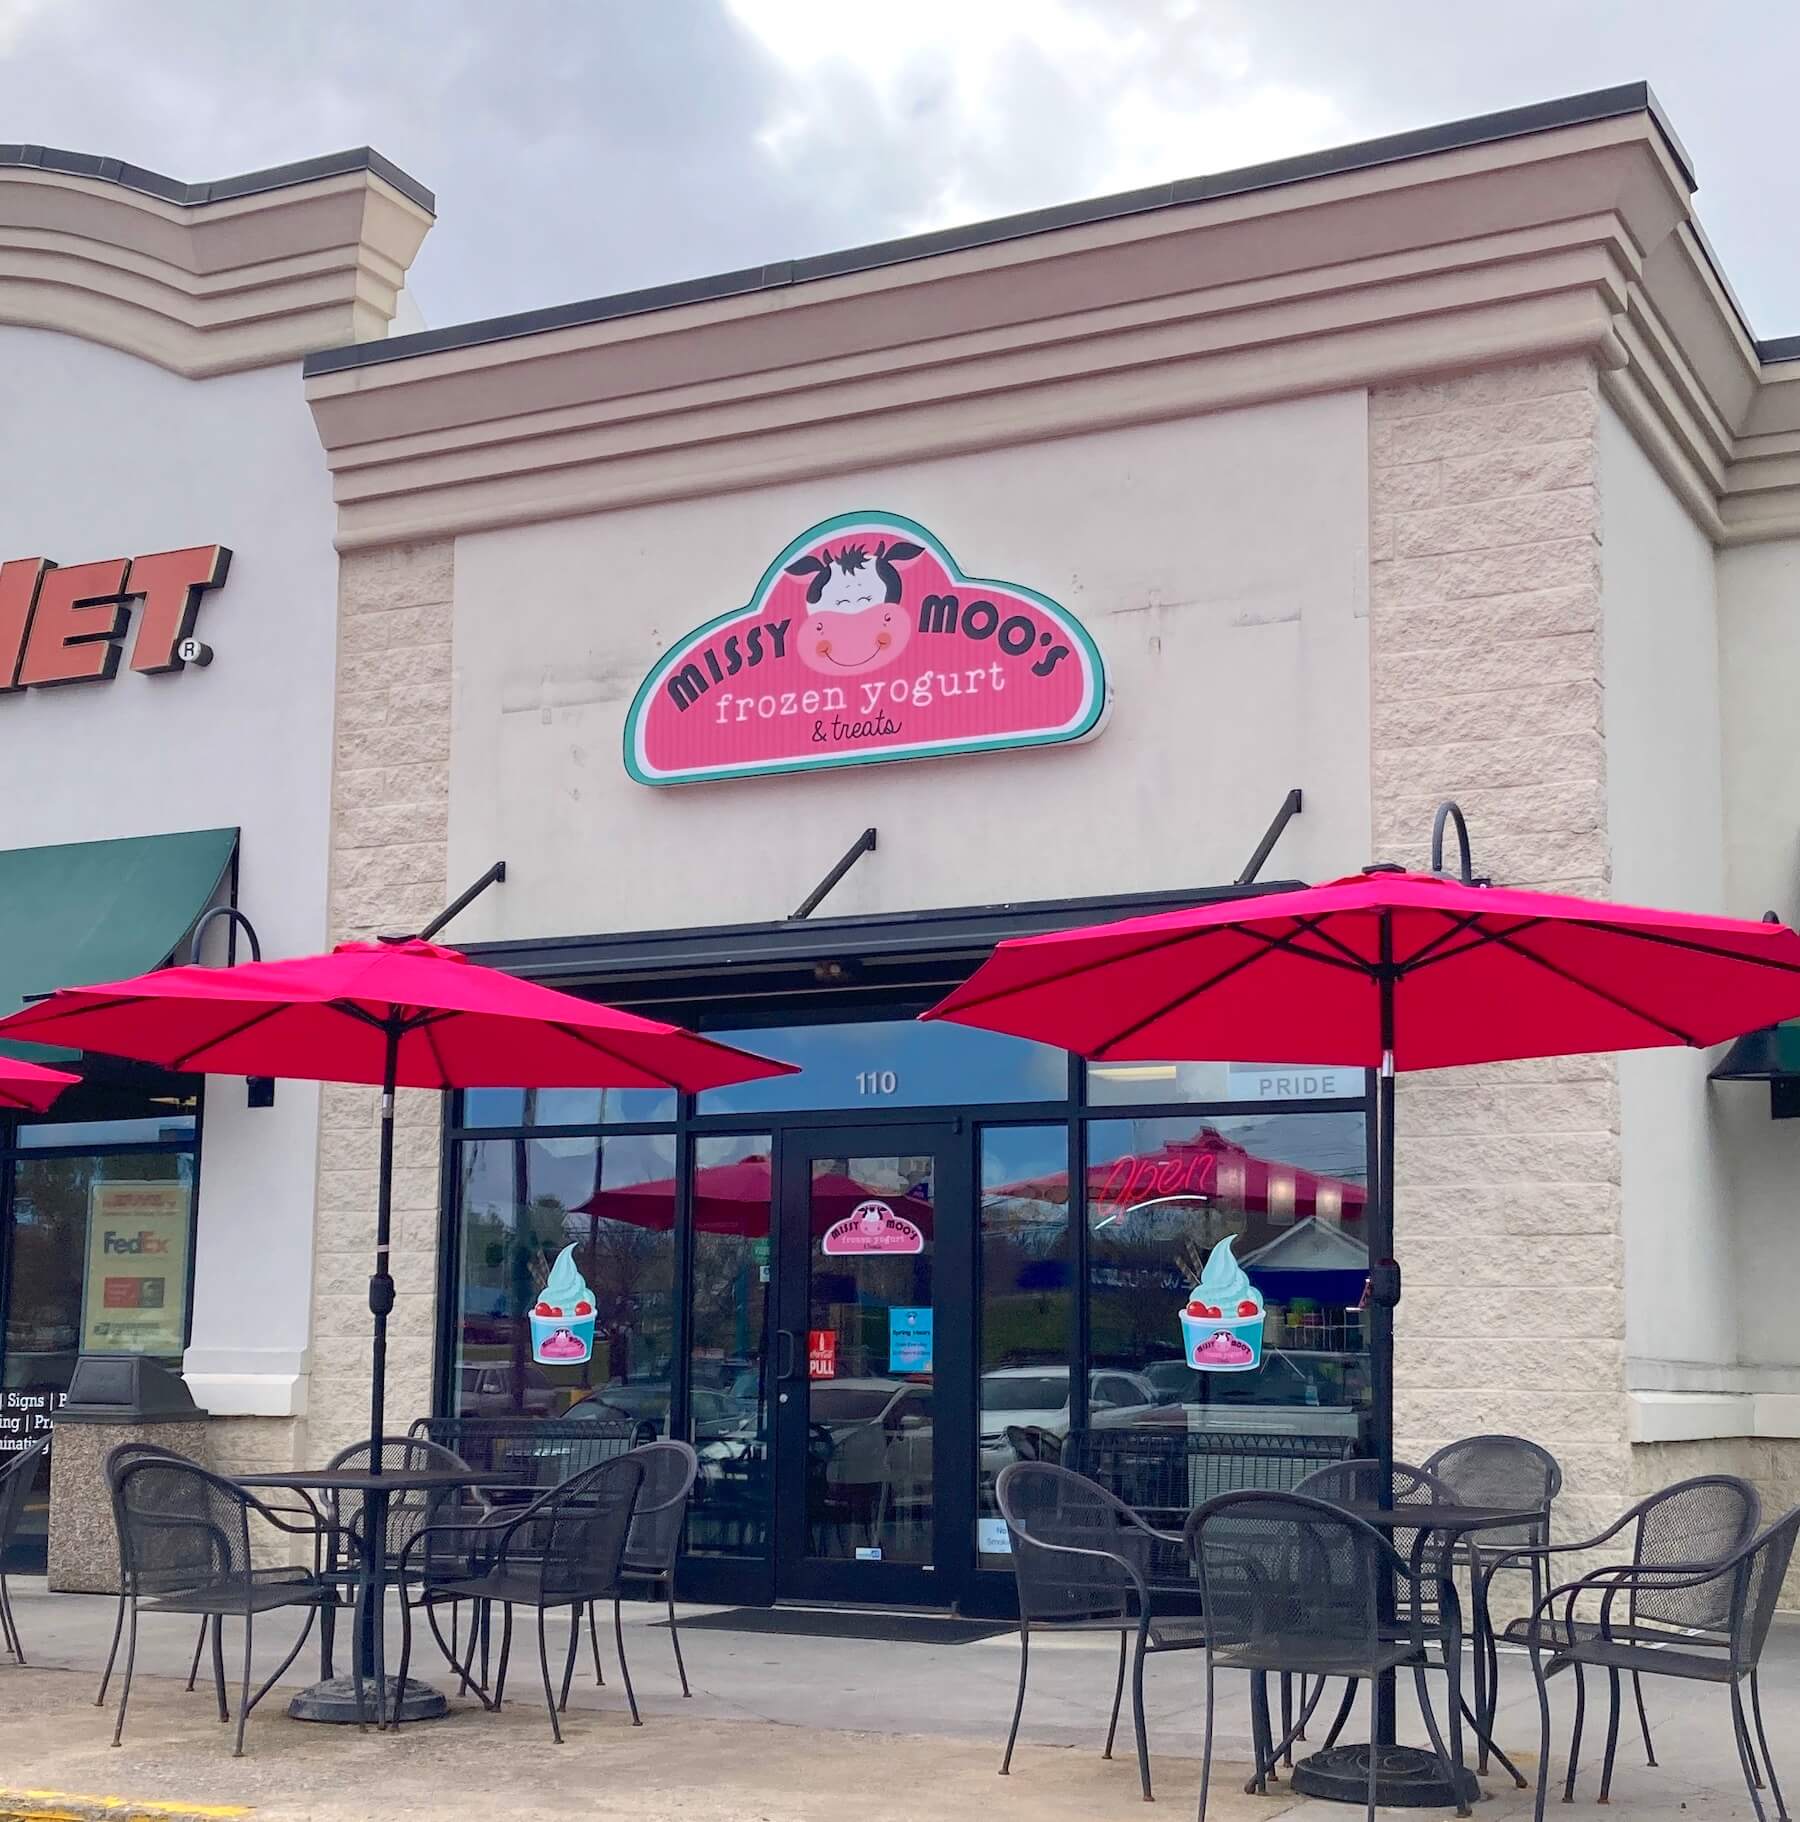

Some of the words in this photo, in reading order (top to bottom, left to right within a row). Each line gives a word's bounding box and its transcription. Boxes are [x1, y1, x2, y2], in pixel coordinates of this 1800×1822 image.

[666, 618, 792, 714] MISSY
[918, 594, 1070, 678] MOO'S
[715, 686, 847, 724] frozen
[860, 661, 1006, 714] yogurt
[811, 720, 827, 742] &
[830, 709, 902, 741] treats
[856, 1071, 897, 1095] 110
[1259, 1075, 1336, 1096] PRIDE
[830, 1221, 860, 1240] MISSY
[104, 1231, 169, 1254] FedEx
[809, 1360, 834, 1375] PULL
[7, 1392, 45, 1411] Signs
